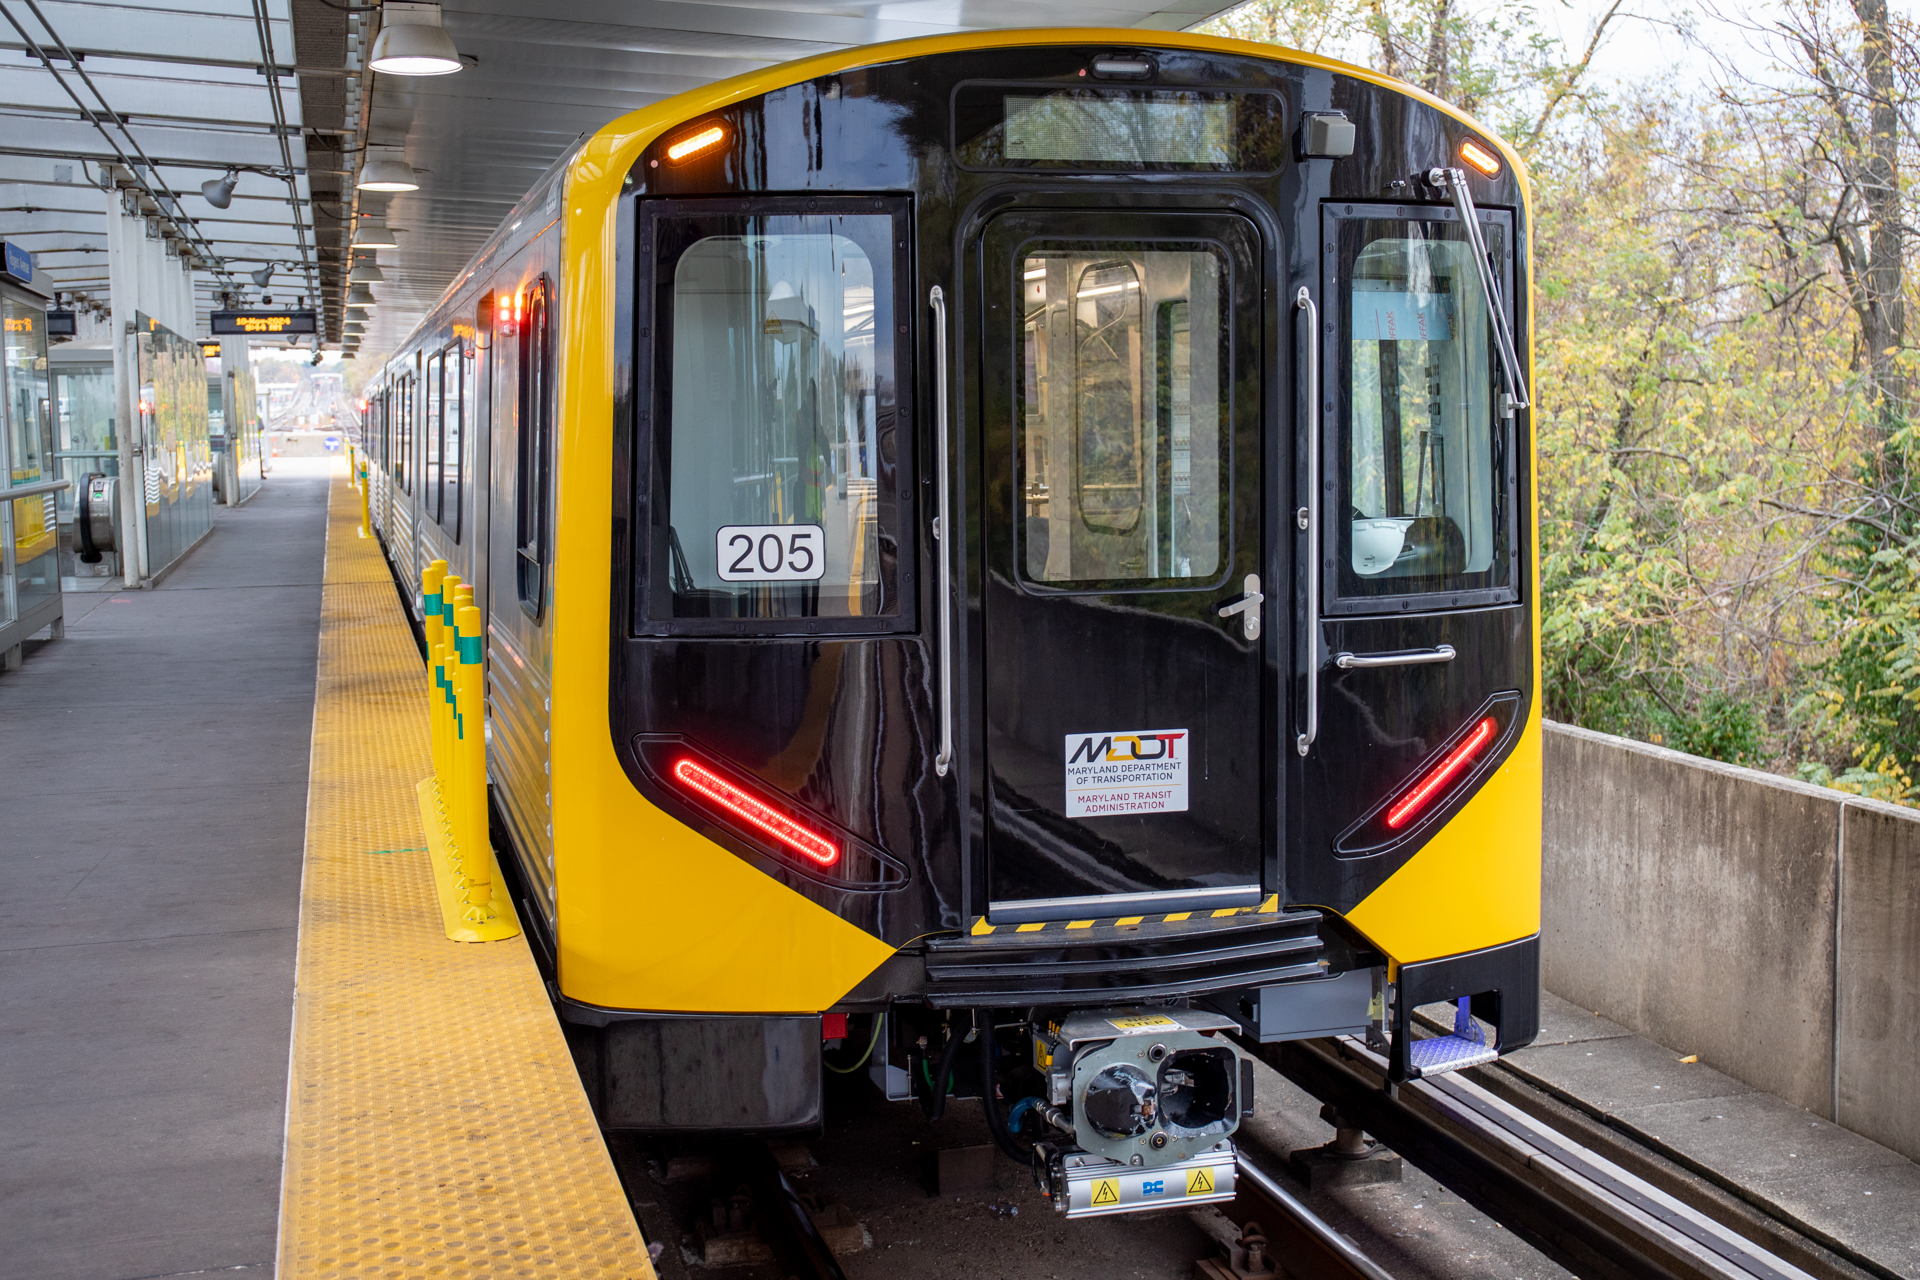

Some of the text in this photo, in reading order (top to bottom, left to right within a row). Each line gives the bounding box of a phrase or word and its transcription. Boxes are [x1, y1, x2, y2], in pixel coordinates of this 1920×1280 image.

[728, 533, 814, 573] 205
[1068, 733, 1186, 764] MDOT
[1068, 762, 1181, 775] MARYLAND DEPARTMENT
[1092, 772, 1173, 783] TRANSPORTATION
[1077, 791, 1172, 803] MARYLAND TRANSIT
[1085, 801, 1165, 812] ADMINISTRATION
